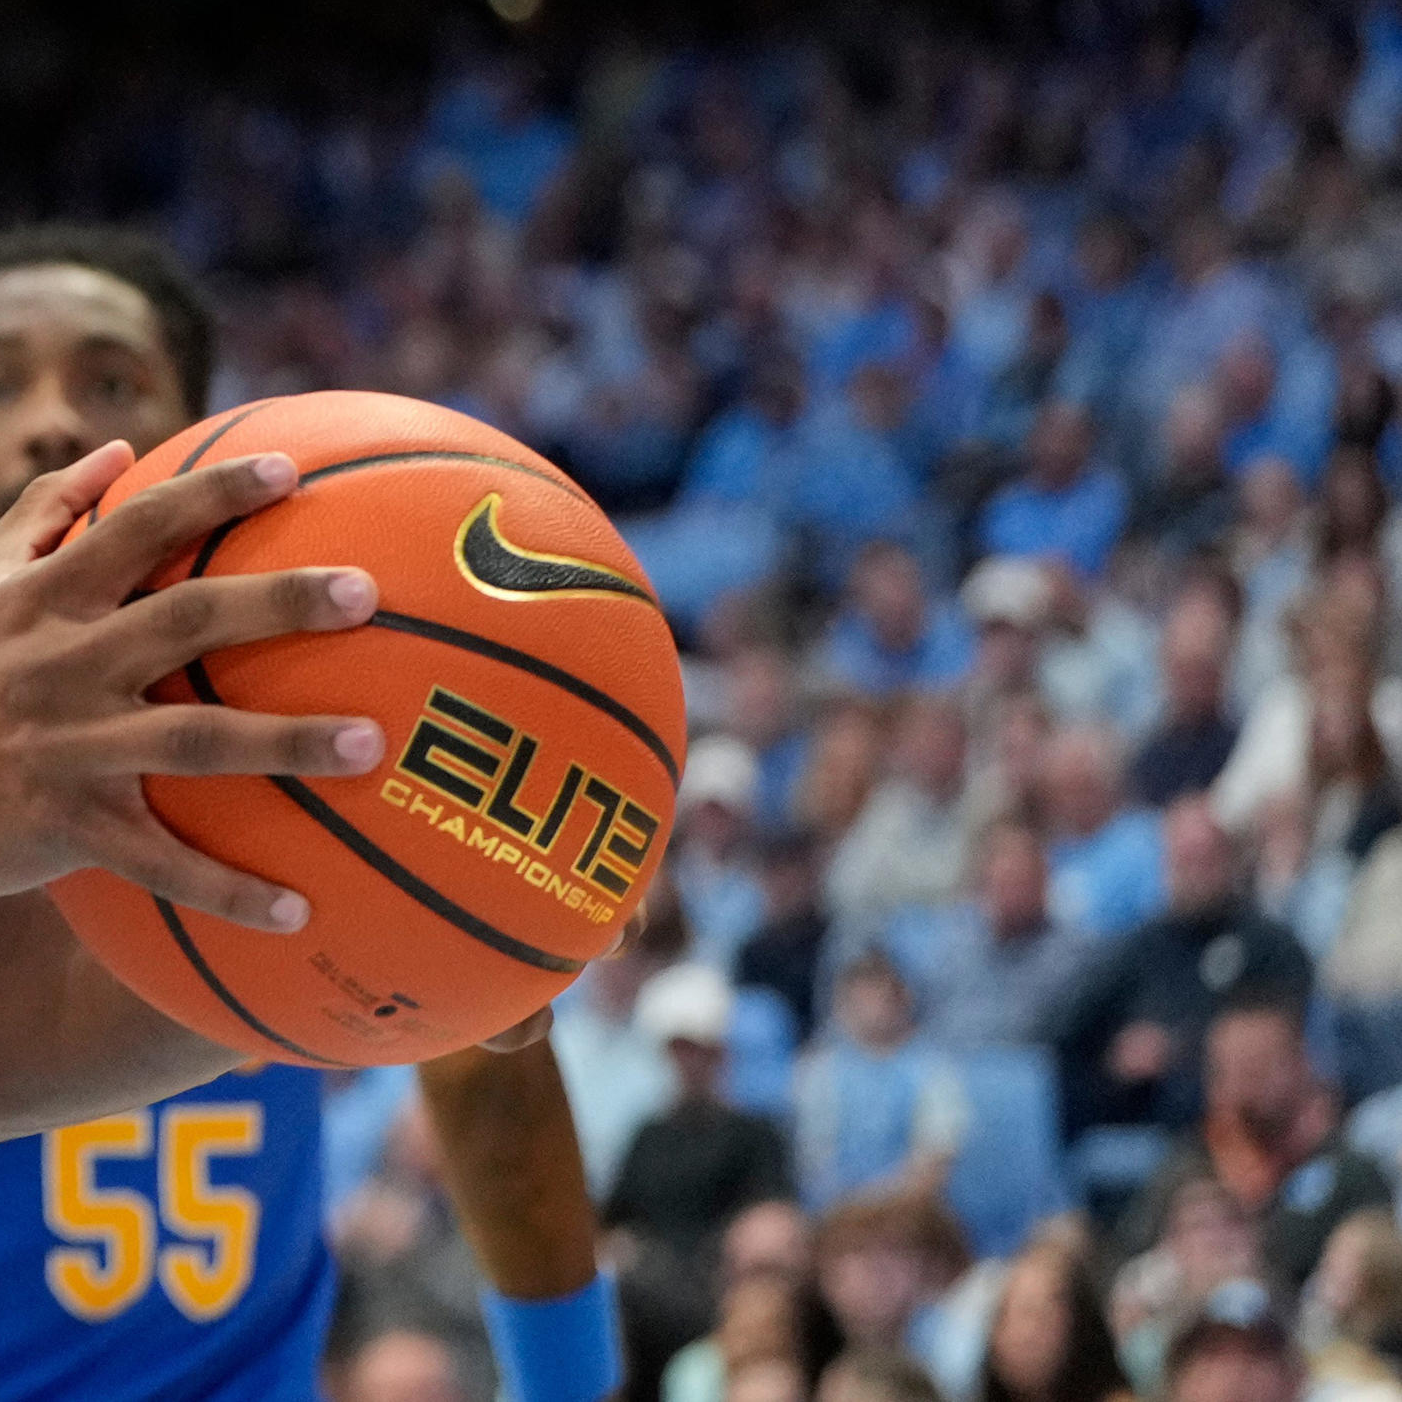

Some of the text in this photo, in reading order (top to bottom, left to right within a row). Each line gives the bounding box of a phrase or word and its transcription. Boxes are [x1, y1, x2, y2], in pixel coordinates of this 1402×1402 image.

[380, 778, 616, 924] CHAMPIONSHIP
[395, 683, 661, 903] ELITE
[41, 1101, 264, 1323] 55
